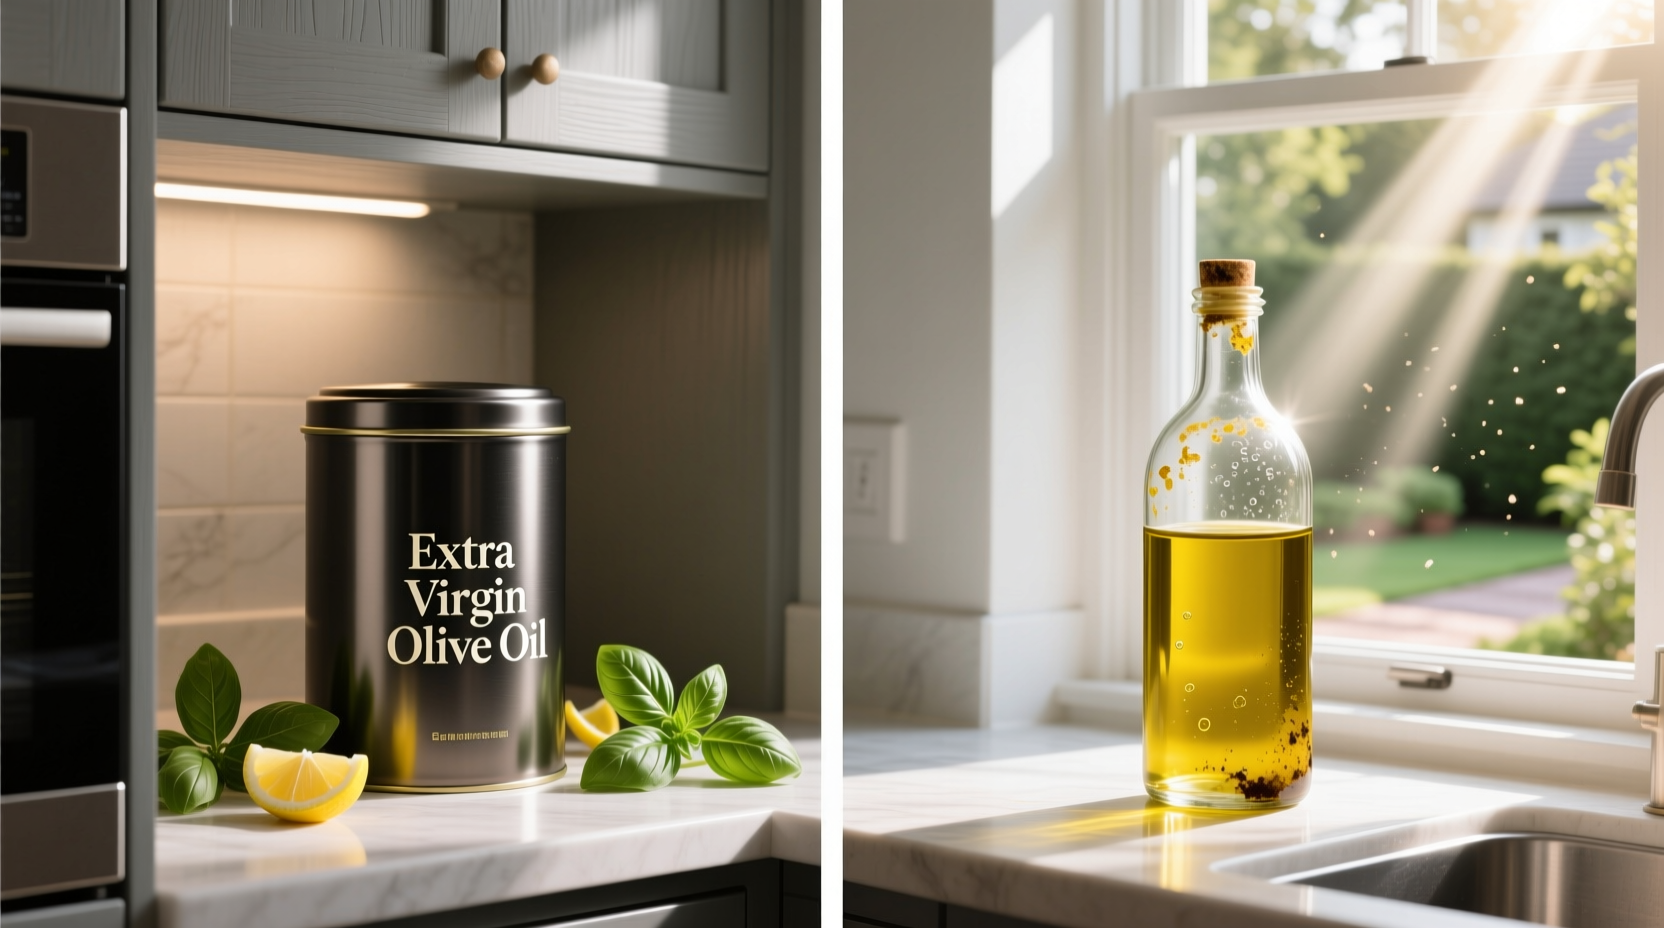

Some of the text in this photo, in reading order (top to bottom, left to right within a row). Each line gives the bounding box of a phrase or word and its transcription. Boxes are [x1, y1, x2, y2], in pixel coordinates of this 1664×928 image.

[408, 533, 516, 570] Extra
[404, 577, 527, 628] Virgin
[387, 617, 548, 665] Olive Oil
